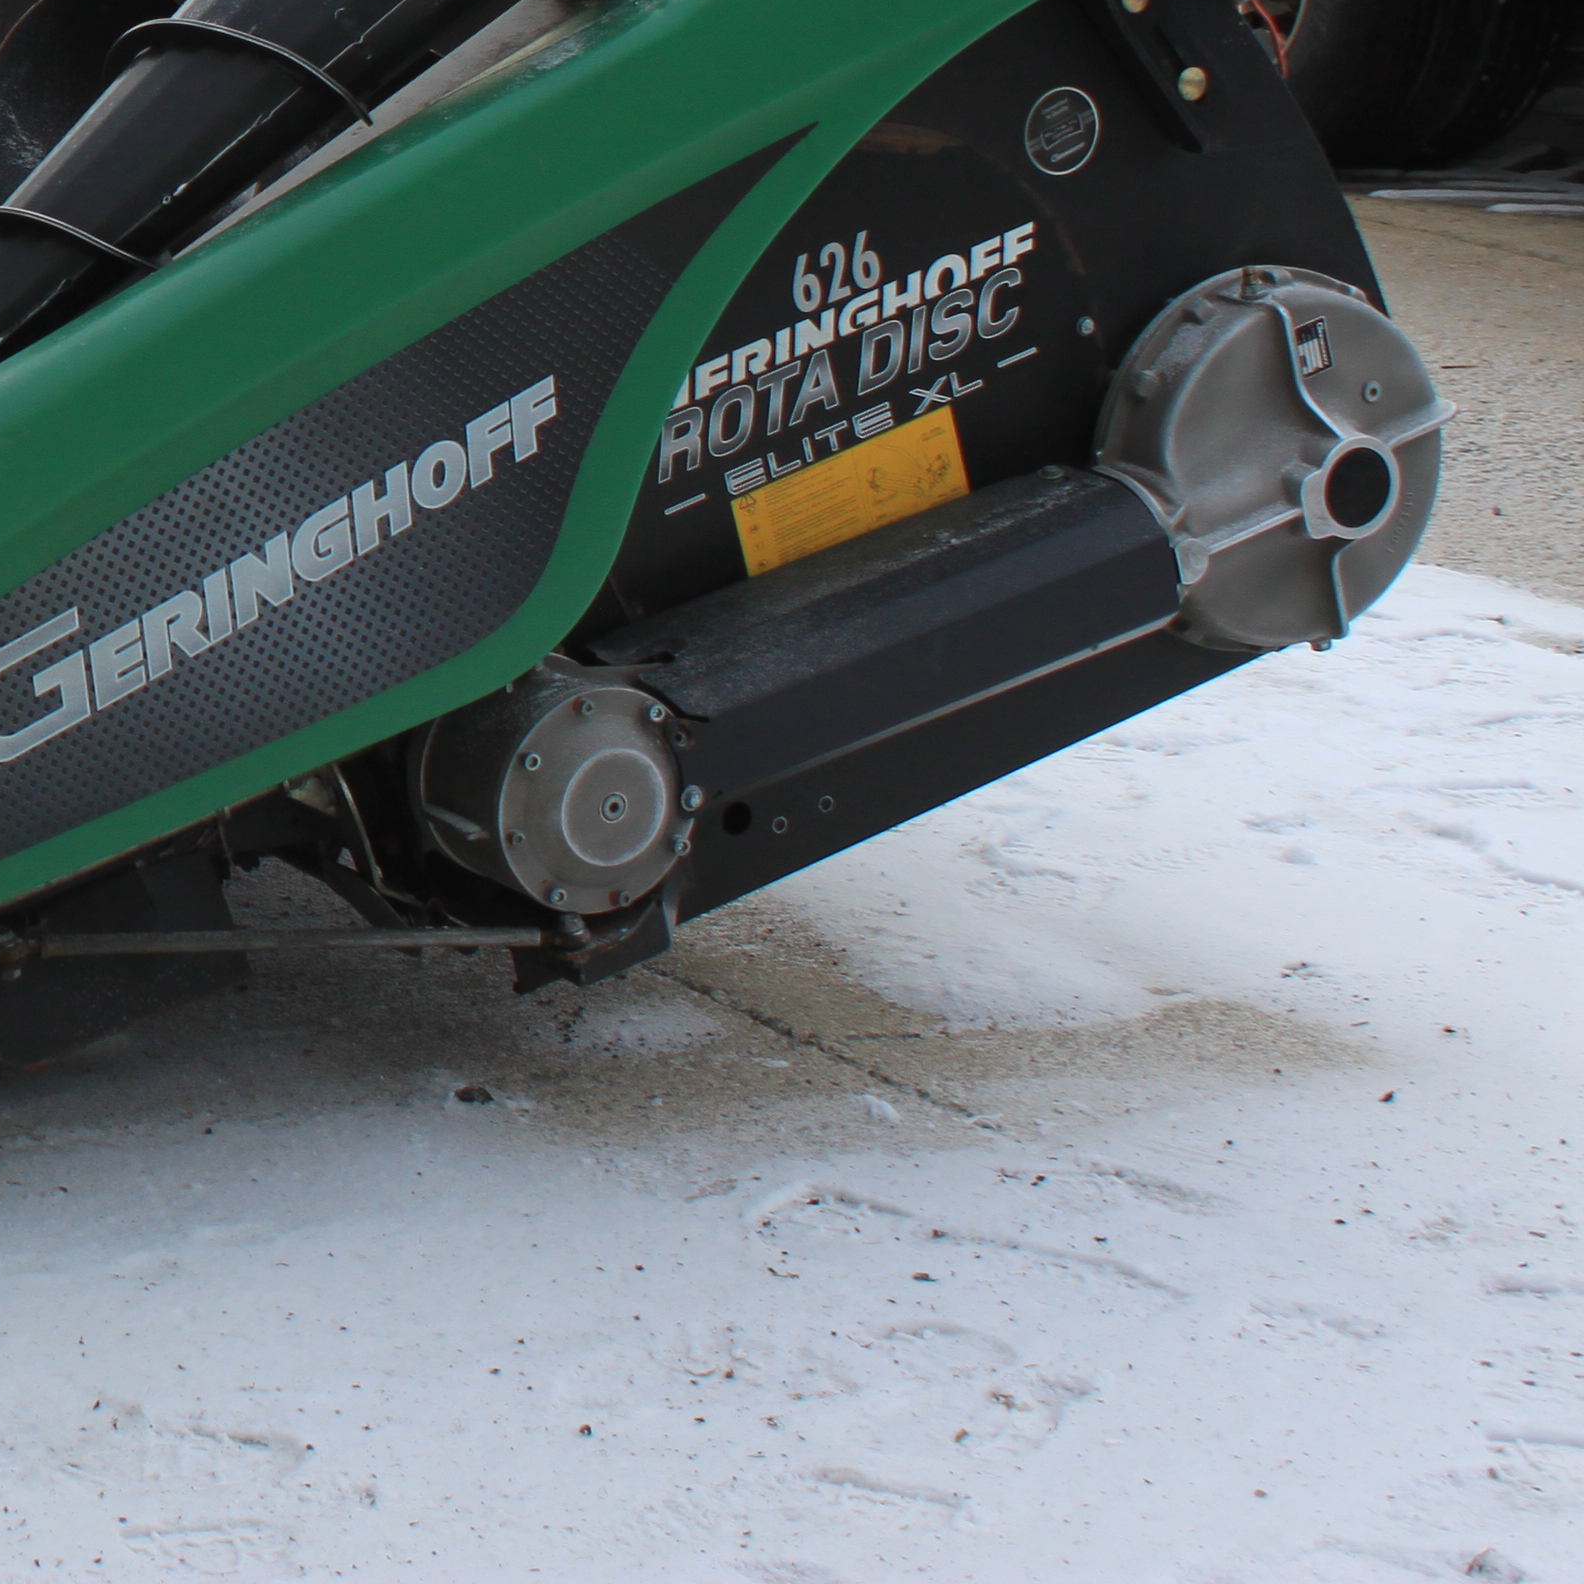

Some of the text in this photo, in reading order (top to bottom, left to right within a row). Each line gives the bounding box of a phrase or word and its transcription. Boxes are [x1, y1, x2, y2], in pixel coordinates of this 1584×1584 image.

[792, 229, 882, 313] 626
[657, 267, 1022, 484] ROTA DISC
[724, 371, 985, 496] ELITE XL
